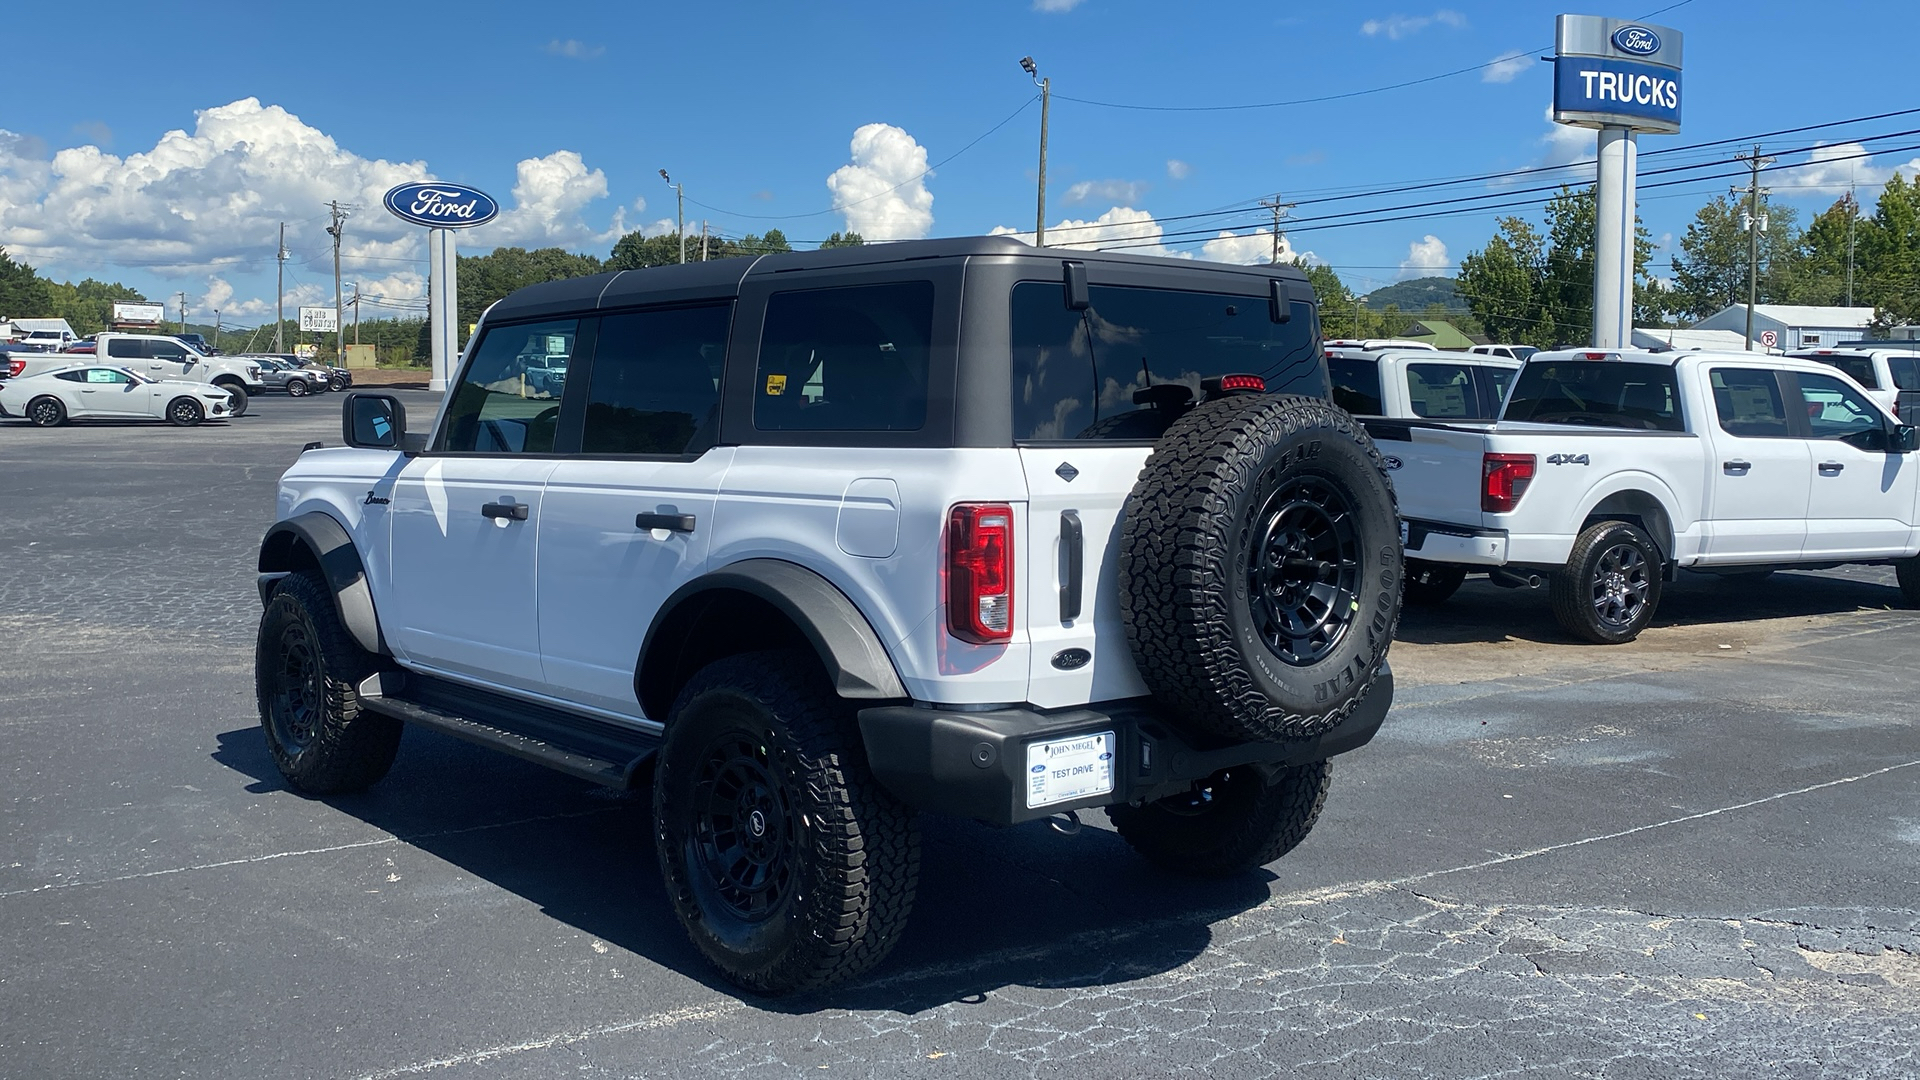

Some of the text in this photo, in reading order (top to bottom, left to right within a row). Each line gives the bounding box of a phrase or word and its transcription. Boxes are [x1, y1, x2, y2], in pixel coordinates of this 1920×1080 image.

[1625, 30, 1653, 50] Ford
[1580, 71, 1677, 109] TRUCKS
[411, 189, 477, 218] Ford
[304, 319, 336, 328] COUNTRY
[363, 490, 391, 505] Bronco
[1061, 653, 1083, 667] Ford
[1050, 740, 1095, 758] JOHN MEGEL
[1051, 768, 1071, 779] TEST
[1072, 764, 1094, 776] DRIVE
